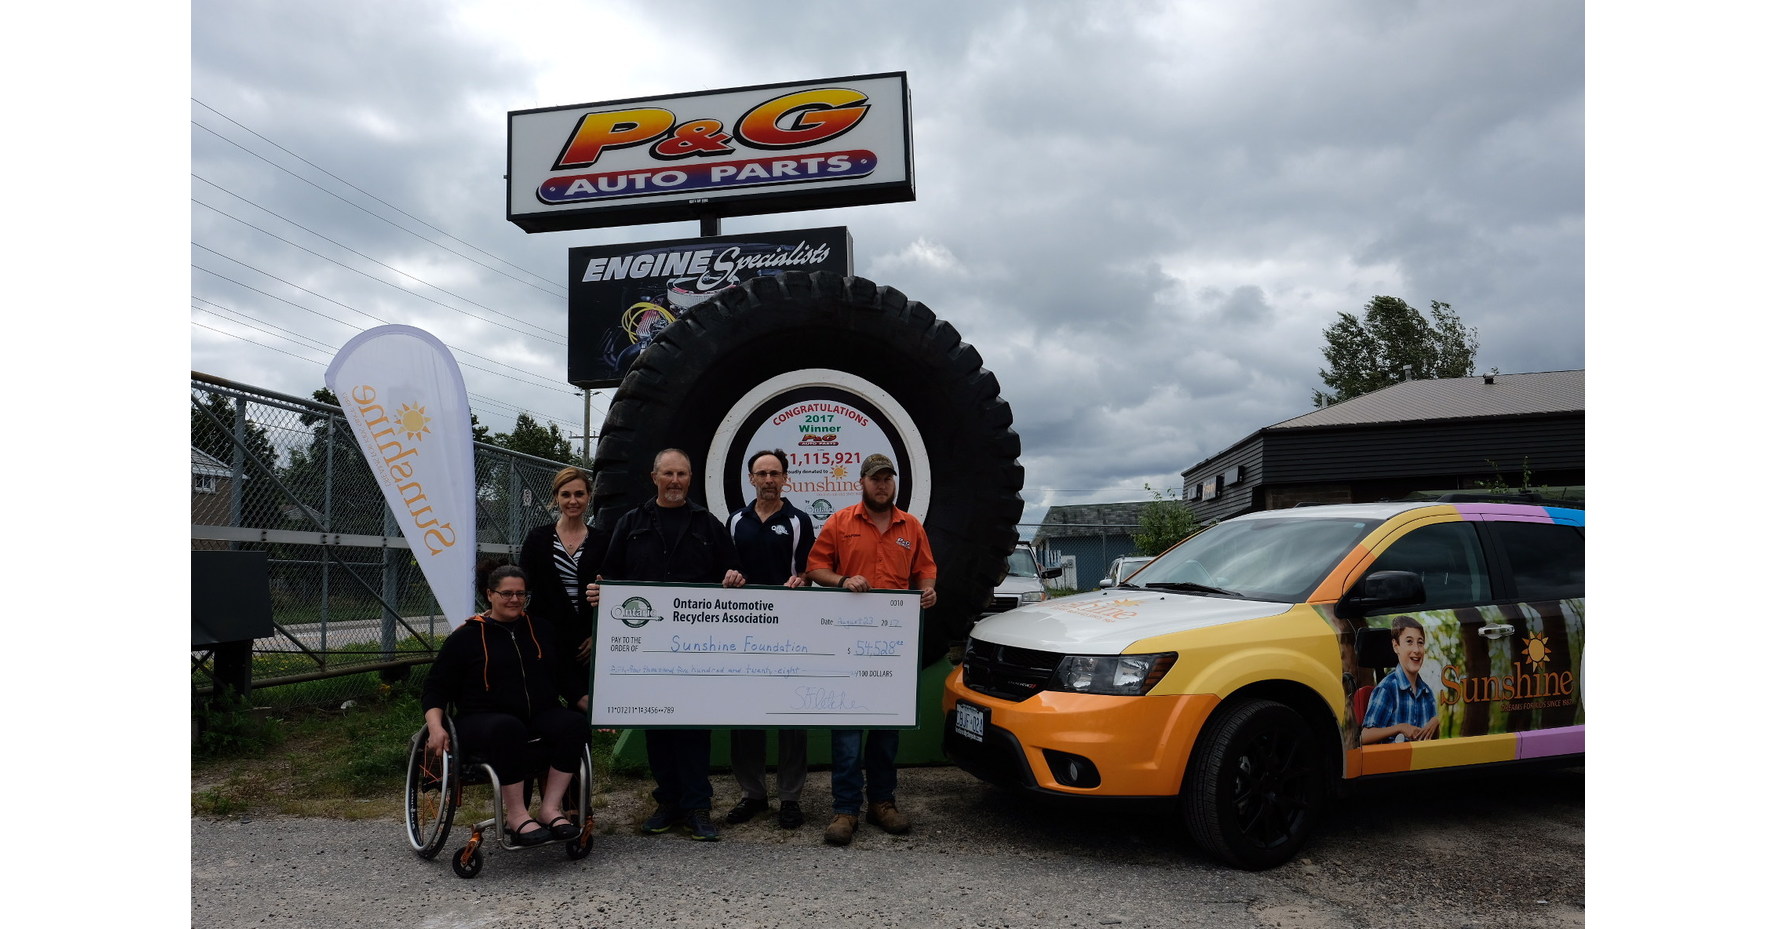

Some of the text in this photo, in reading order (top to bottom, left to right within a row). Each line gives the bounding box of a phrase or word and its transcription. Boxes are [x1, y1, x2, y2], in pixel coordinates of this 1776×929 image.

[551, 87, 871, 171] P&G
[563, 154, 852, 196] AUTO PARTS
[582, 240, 830, 291] ENGINE Specialists
[772, 403, 869, 427] CONGRATULATIONS
[805, 415, 834, 423] 2017
[799, 425, 841, 433] Winner
[786, 452, 860, 466] 1,115,921
[780, 476, 863, 493] Sunshine
[673, 598, 774, 611] Ontario Automotive
[673, 611, 779, 625] Recyclers Association
[820, 618, 833, 626] Date
[671, 635, 808, 653] Sunshine Foundation
[1440, 662, 1574, 705] Sunshine
[1547, 700, 1561, 708] SINCE
